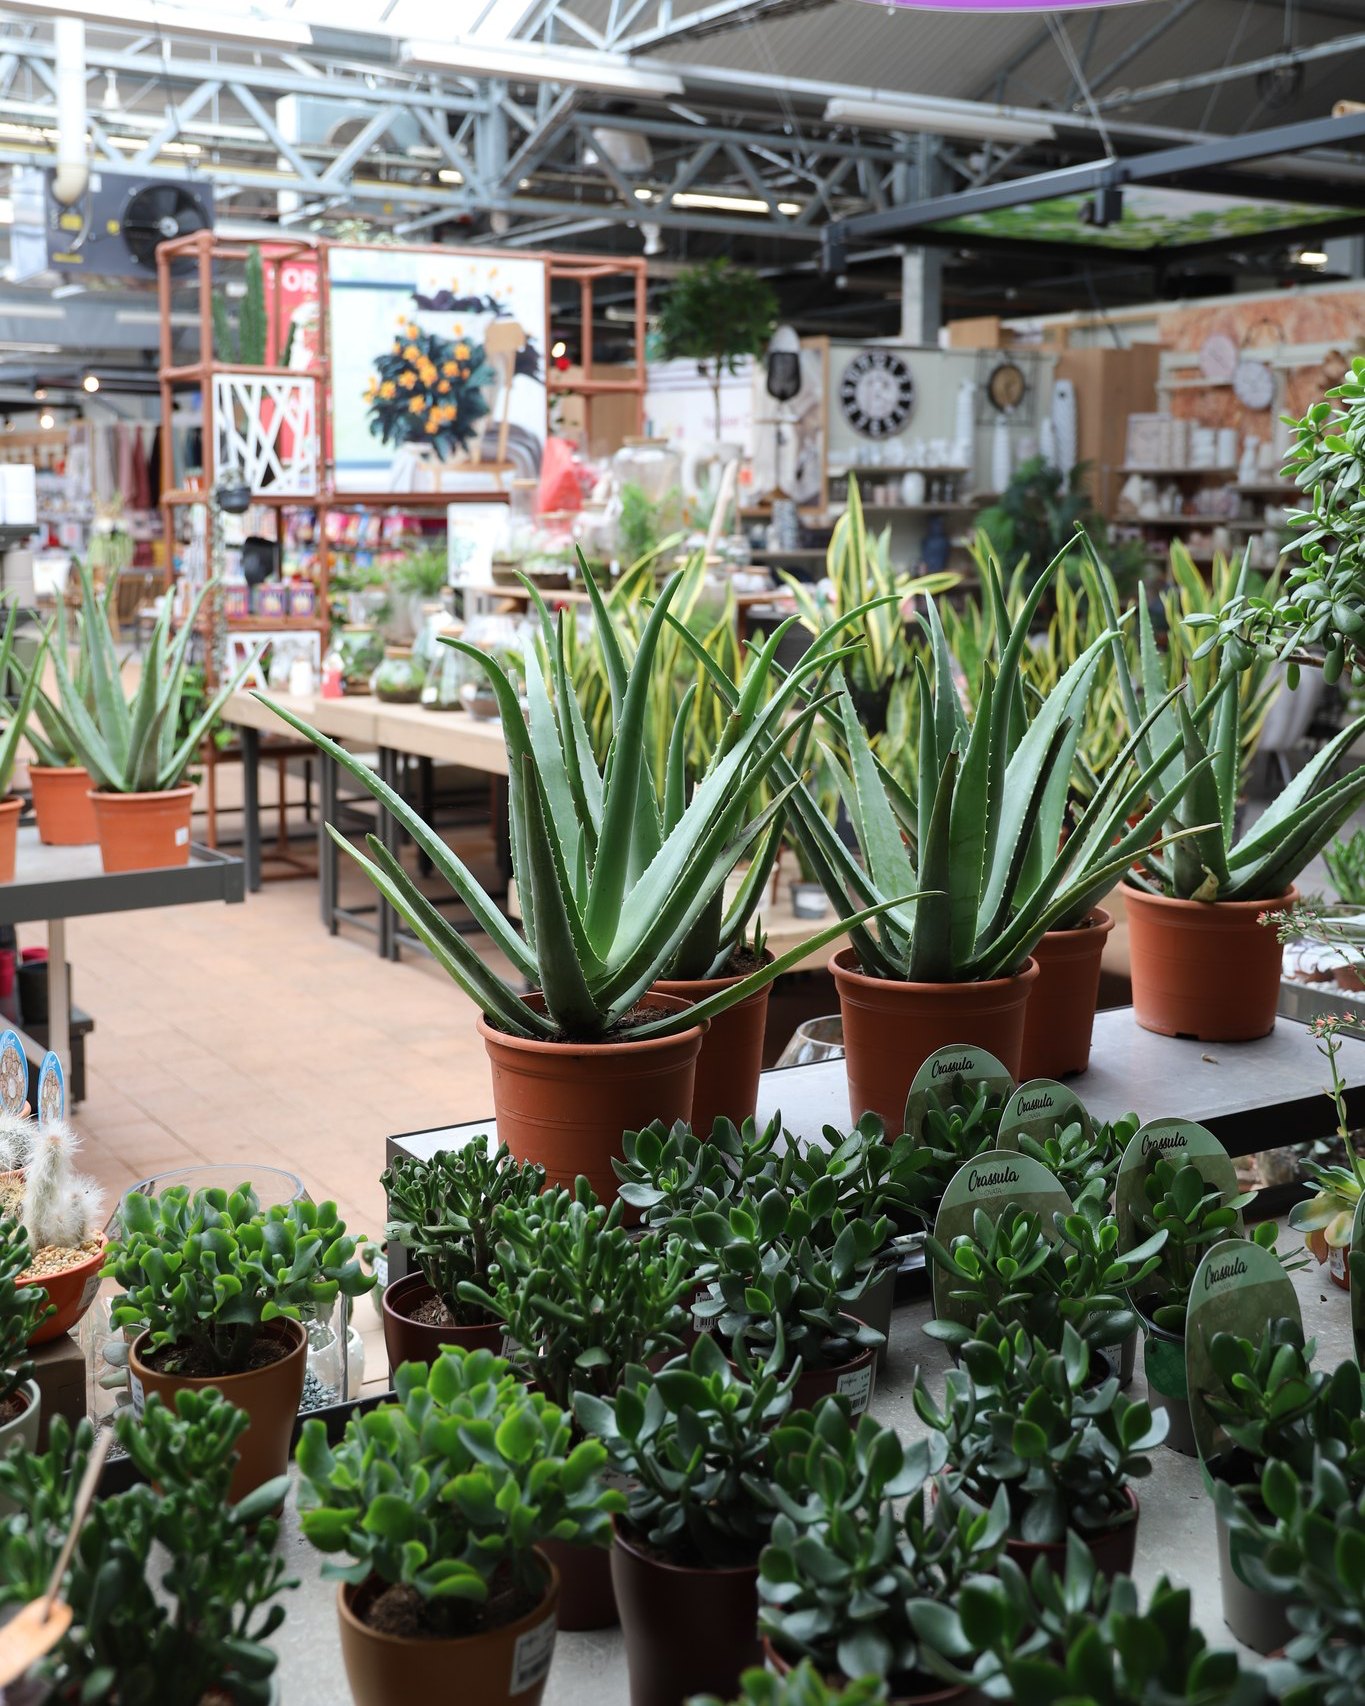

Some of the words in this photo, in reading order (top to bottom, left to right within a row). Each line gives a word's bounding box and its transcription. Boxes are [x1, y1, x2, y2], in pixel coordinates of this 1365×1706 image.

[931, 1056, 975, 1079] Crassula
[1017, 1092, 1055, 1116] Crassula
[1141, 1131, 1188, 1156] Crassula
[968, 1165, 1020, 1193] Crassula
[1204, 1256, 1249, 1291] Crassula
